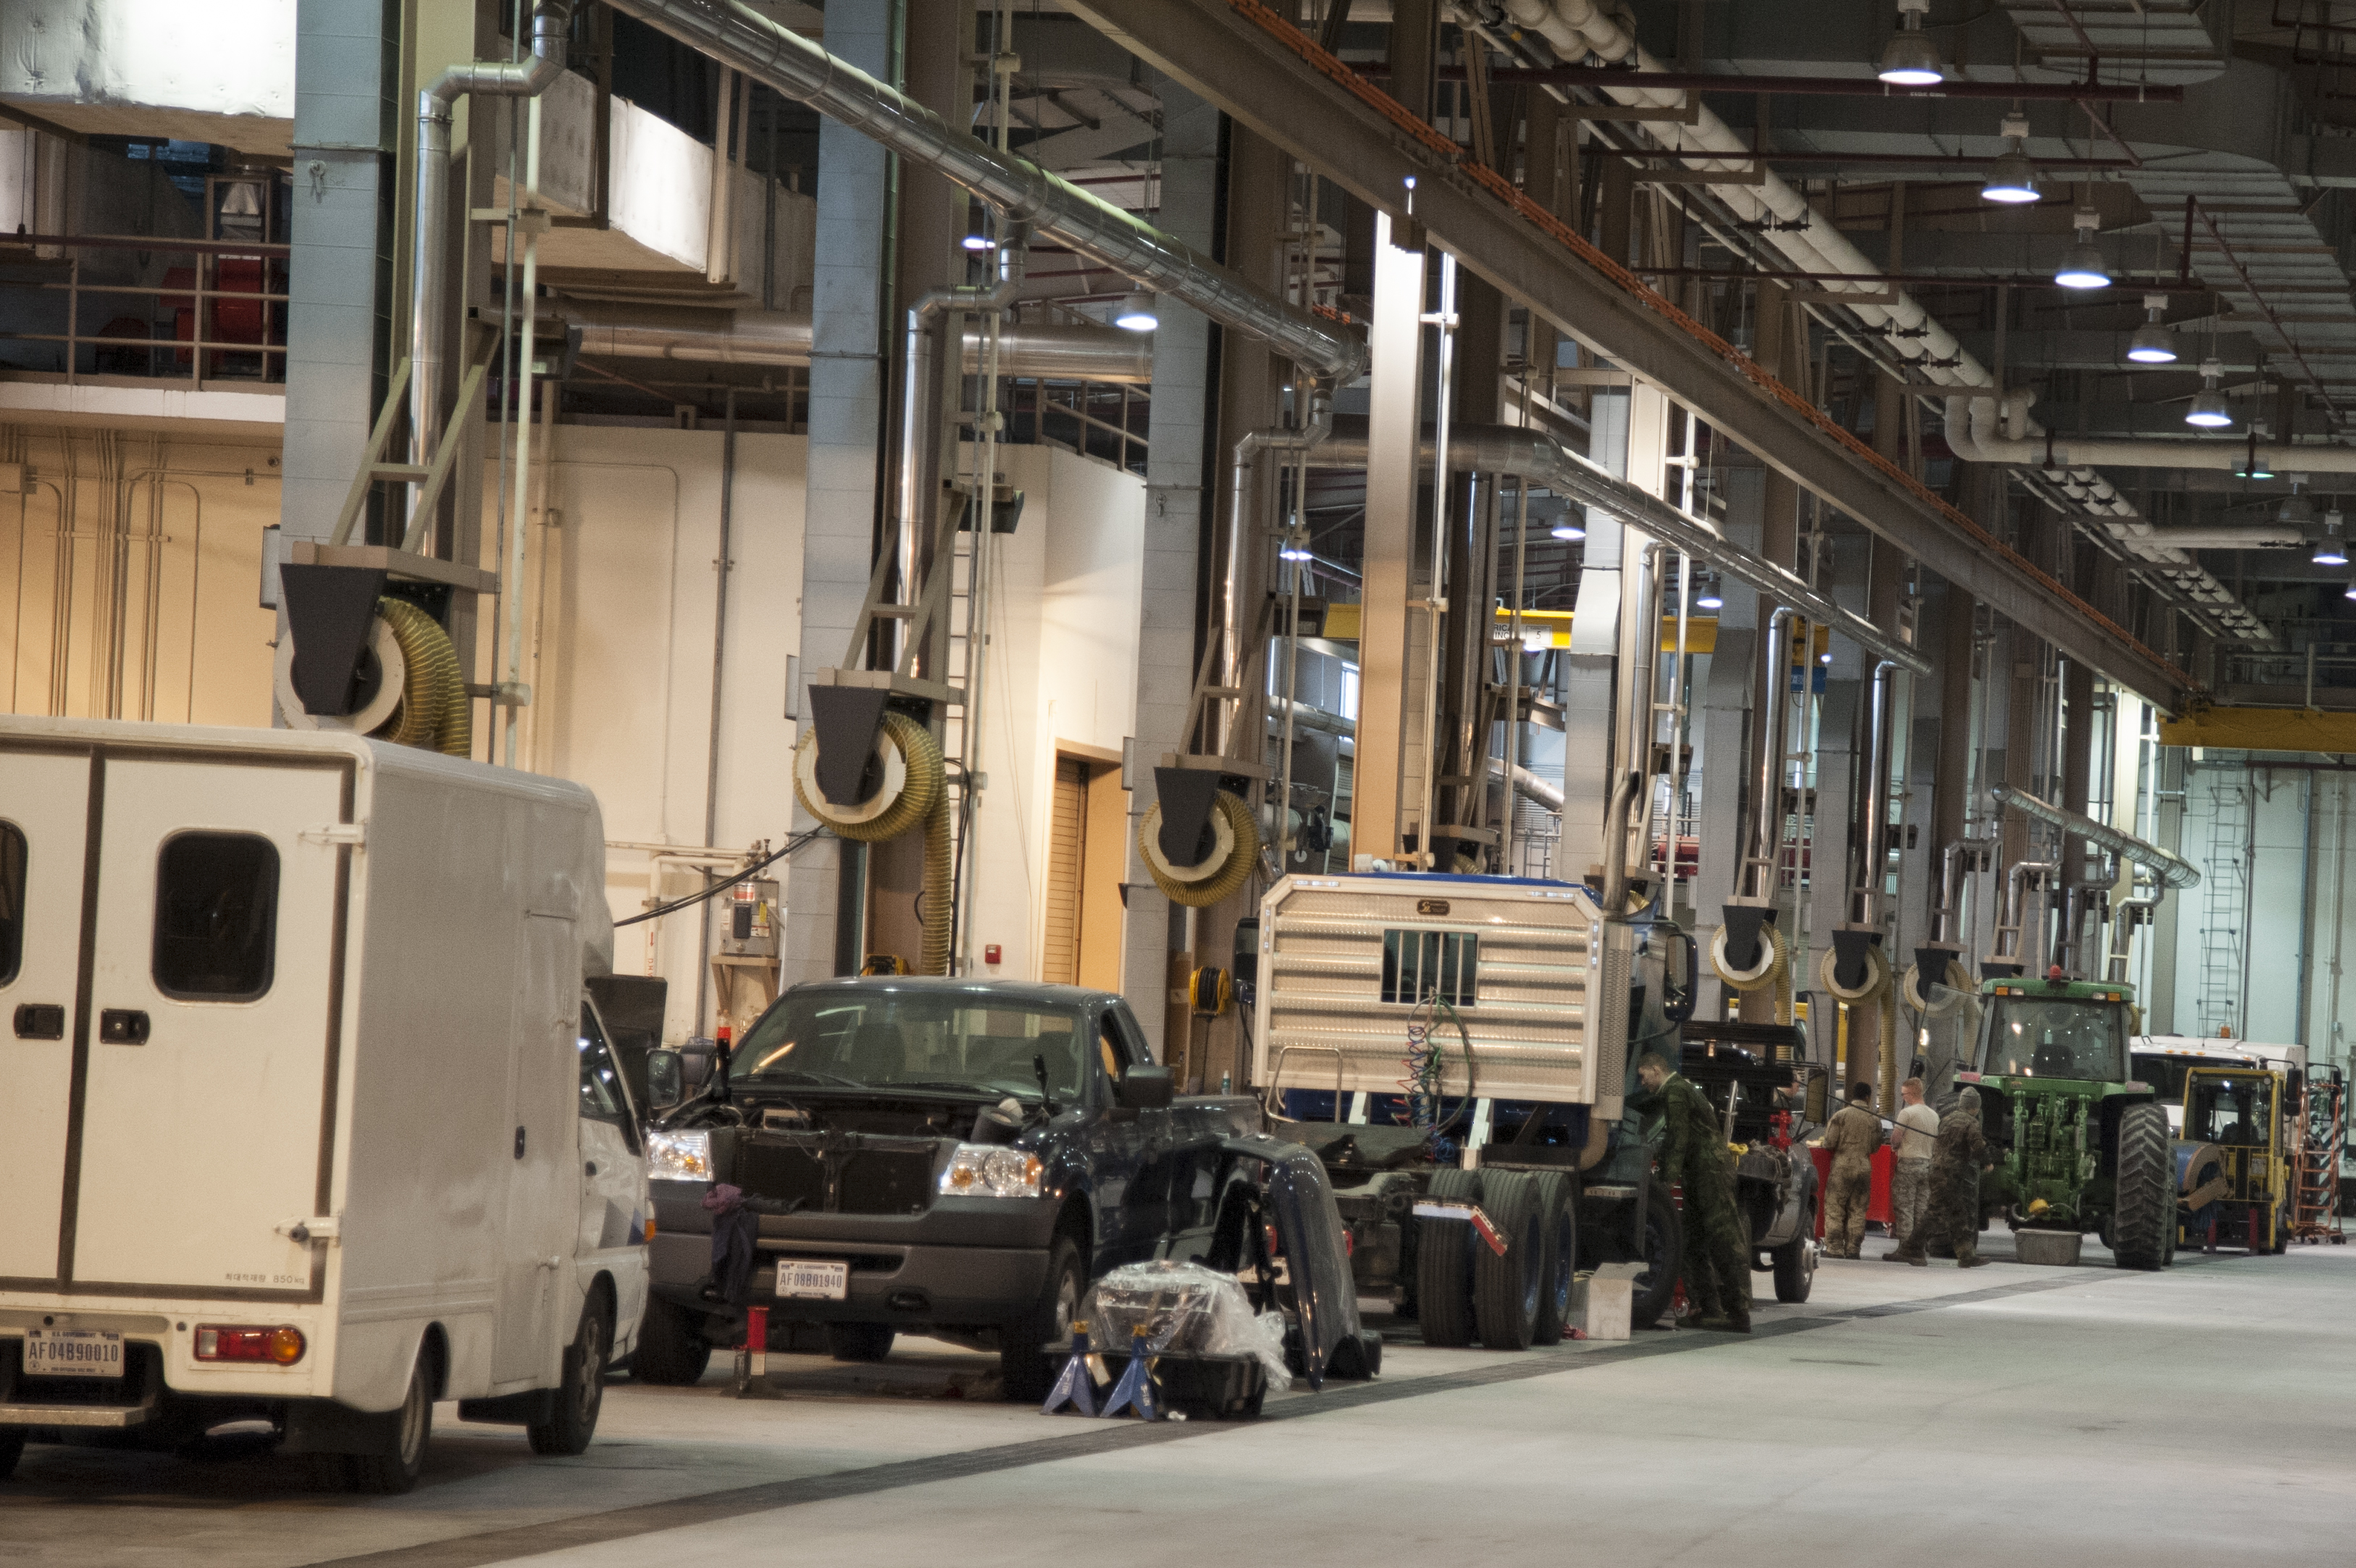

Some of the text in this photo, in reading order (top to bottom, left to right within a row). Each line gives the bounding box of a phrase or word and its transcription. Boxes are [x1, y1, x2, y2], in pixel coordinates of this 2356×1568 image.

[1536, 631, 1541, 640] 5
[780, 1273, 842, 1288] AF08B01940
[29, 1342, 118, 1362] AF04B90010
